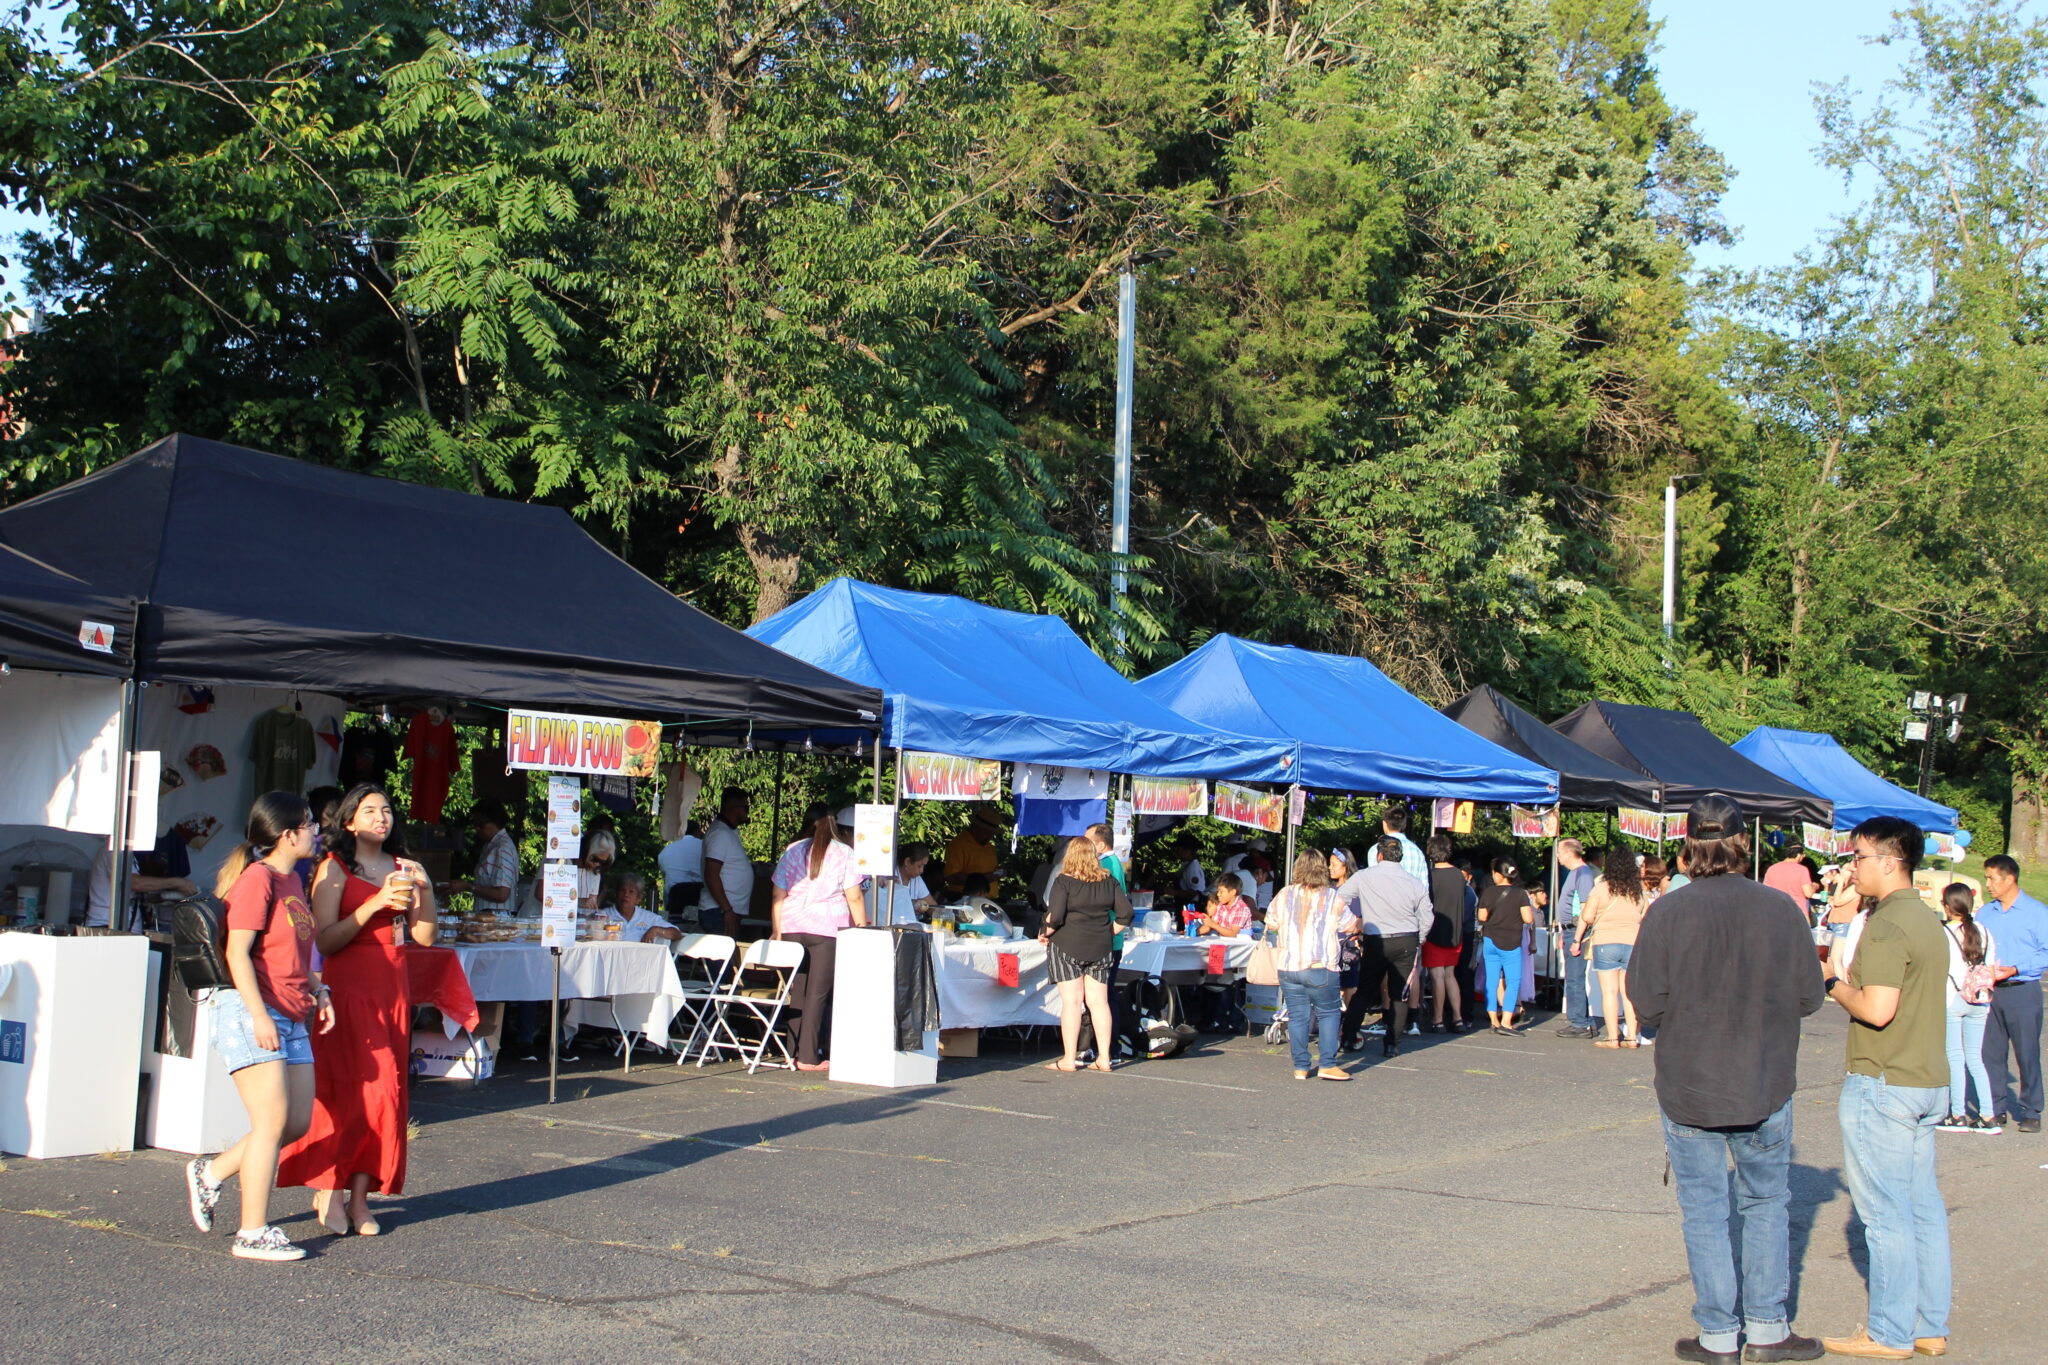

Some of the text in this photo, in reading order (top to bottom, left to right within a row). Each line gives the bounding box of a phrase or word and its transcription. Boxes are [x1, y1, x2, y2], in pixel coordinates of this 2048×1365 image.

[510, 714, 623, 770] FILIPINO FOOD
[1620, 806, 1659, 840] DRINKS
